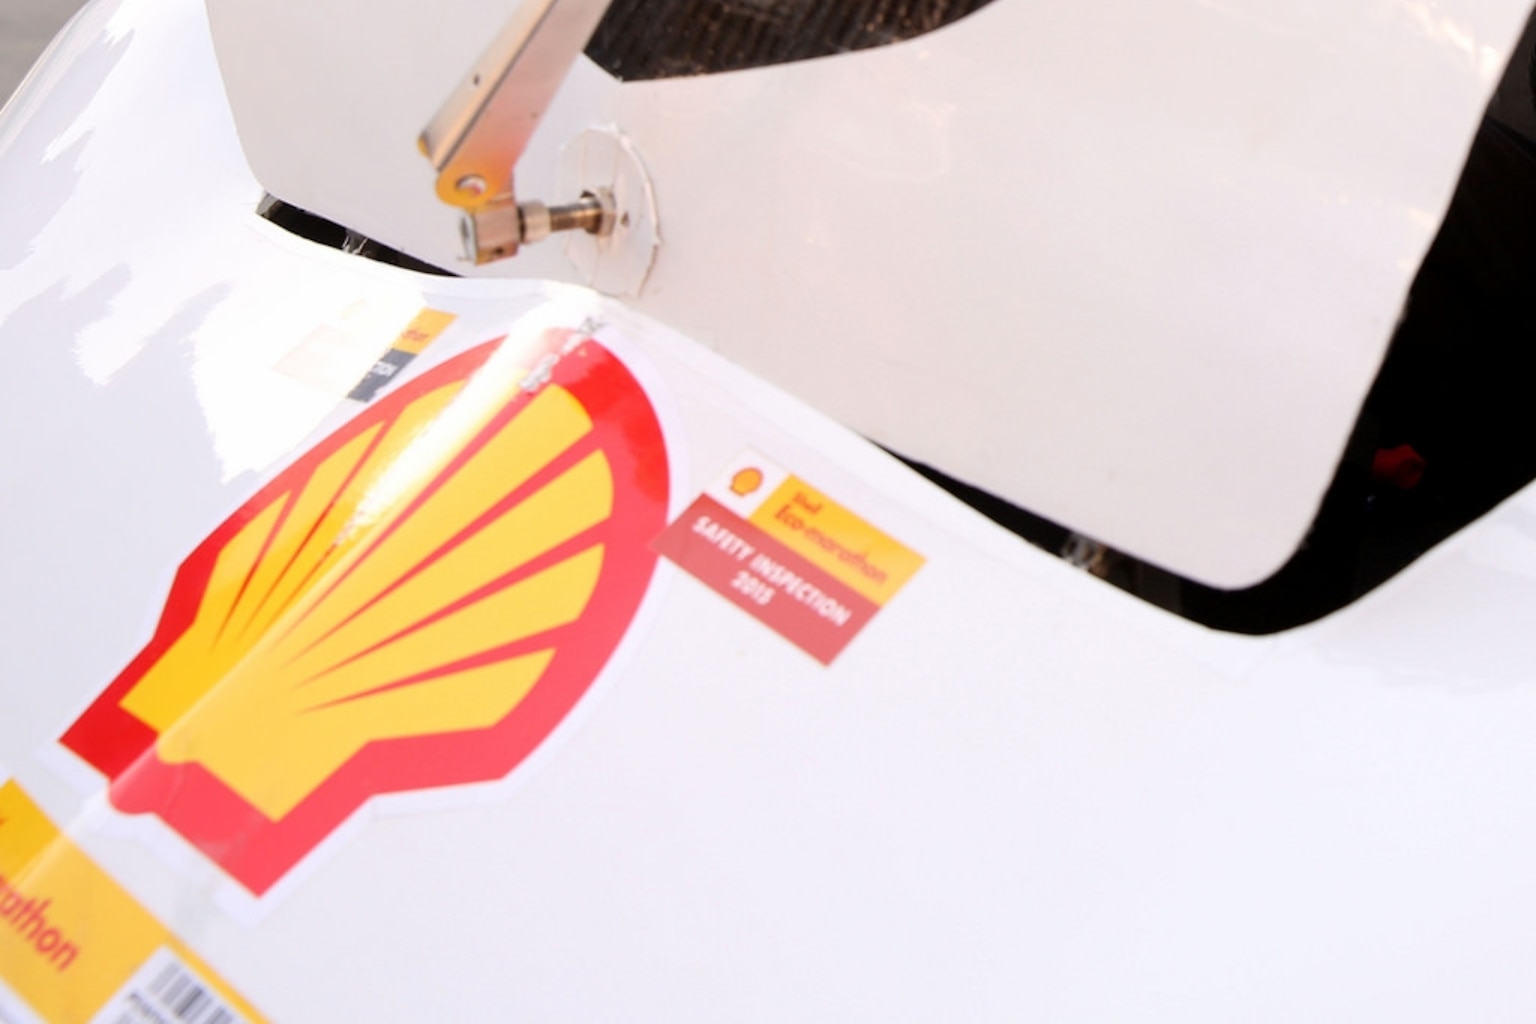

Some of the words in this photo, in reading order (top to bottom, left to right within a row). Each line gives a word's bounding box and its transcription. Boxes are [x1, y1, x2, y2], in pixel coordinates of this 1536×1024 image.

[692, 514, 756, 562] SAFETY
[749, 552, 853, 627] INSPECTION
[730, 569, 777, 606] 2015
